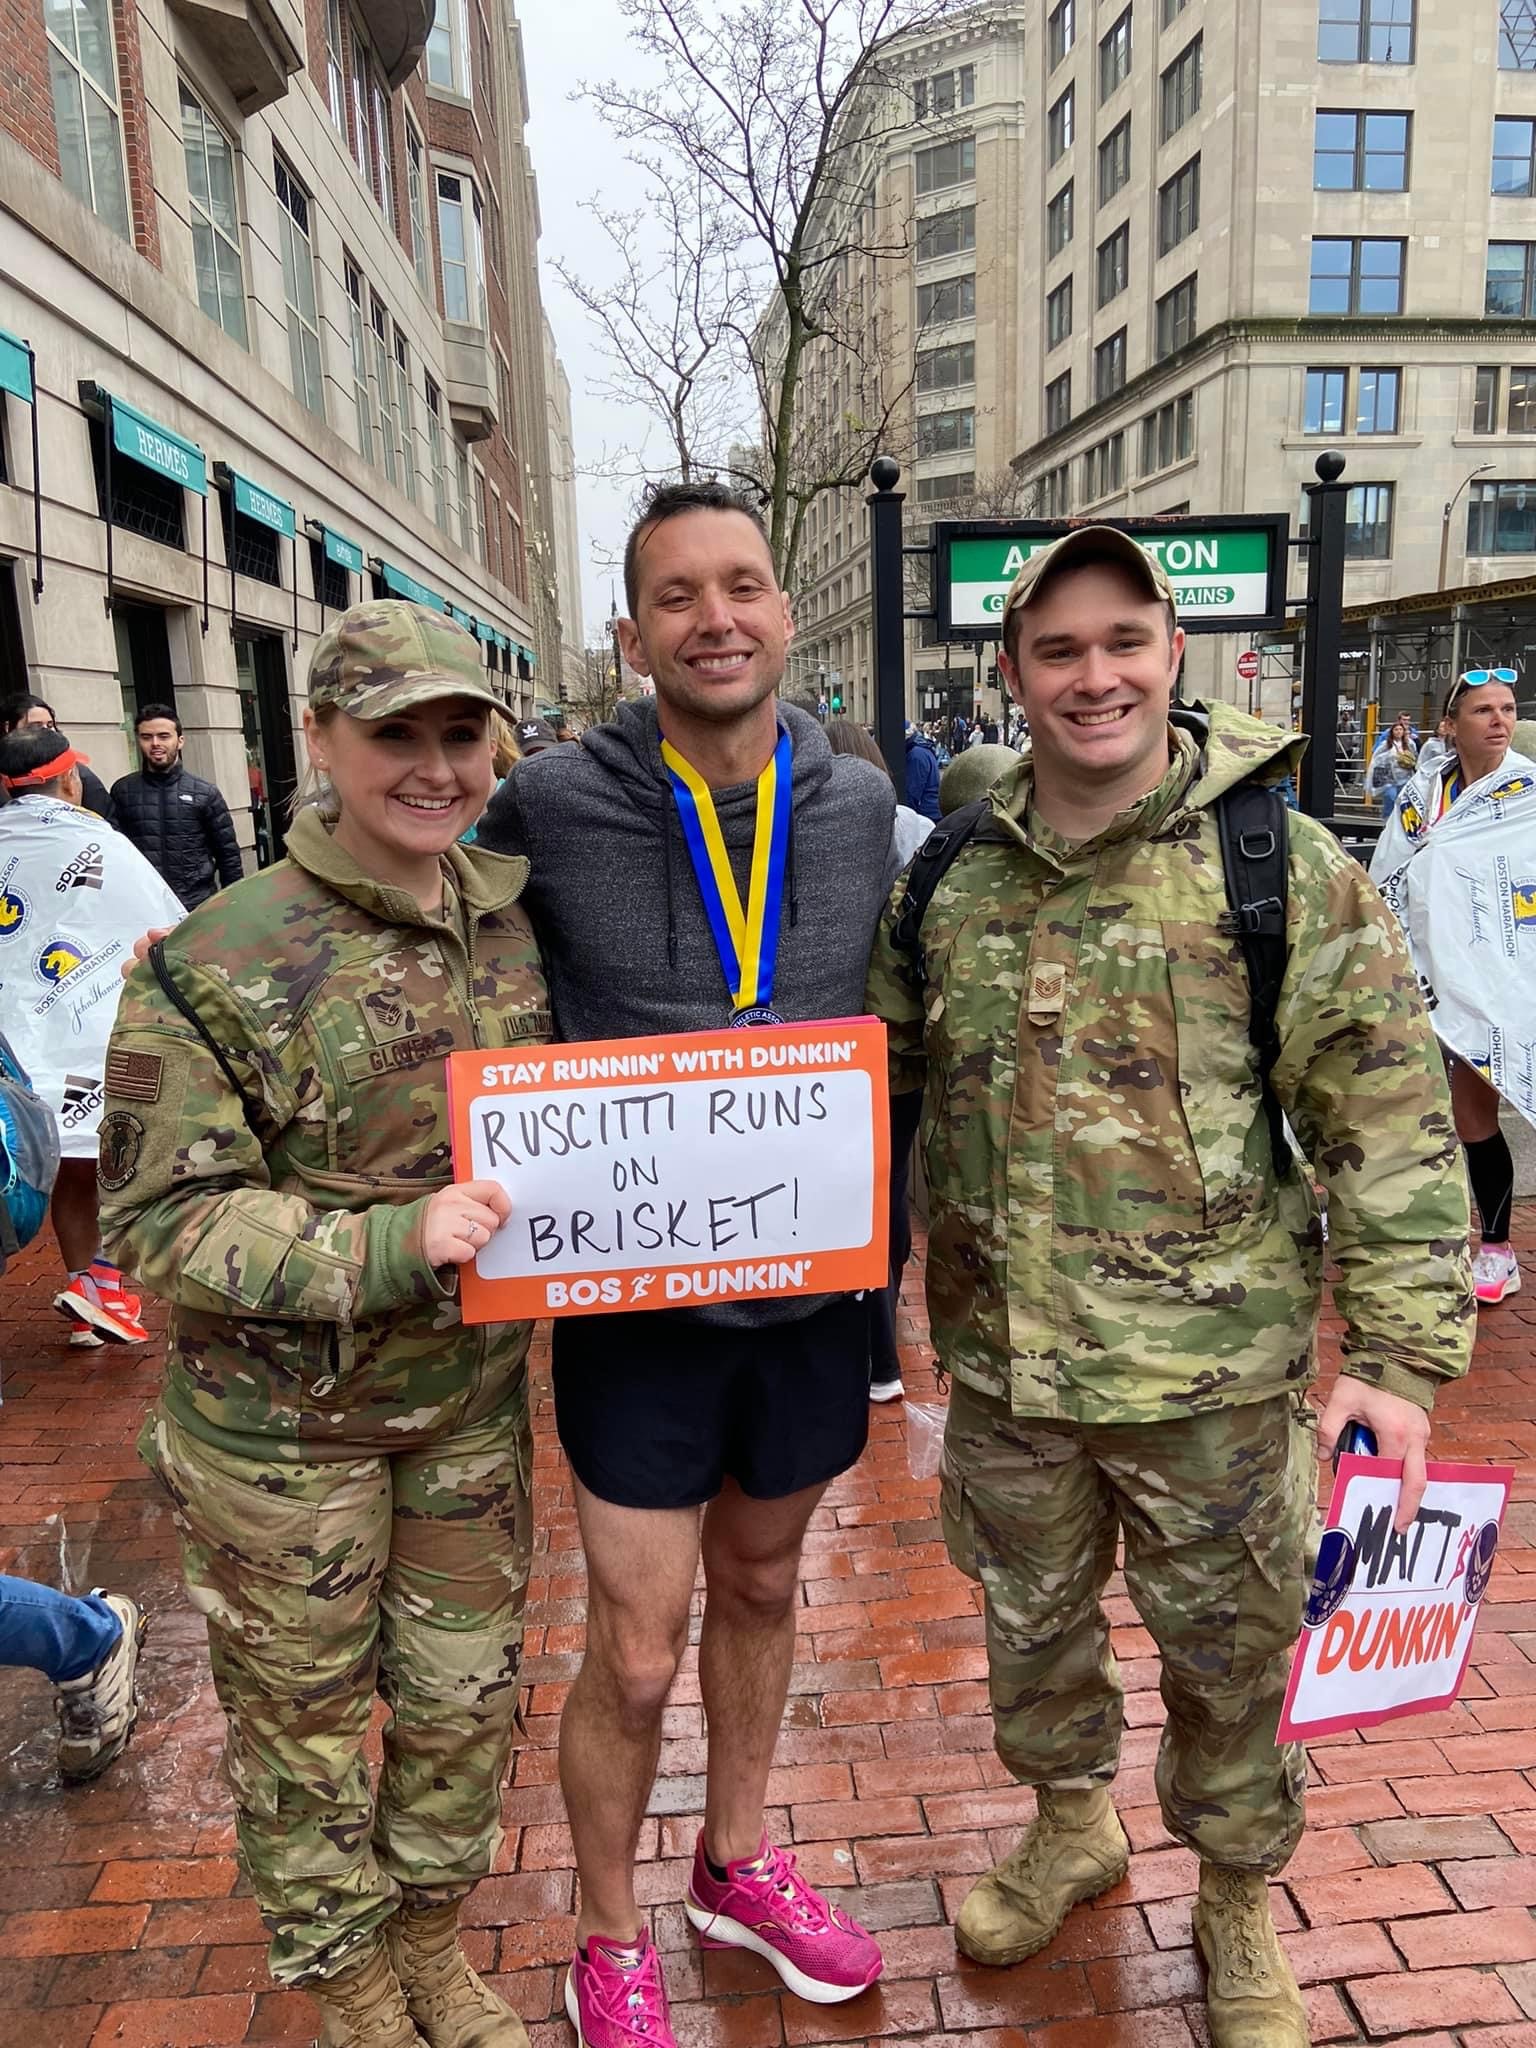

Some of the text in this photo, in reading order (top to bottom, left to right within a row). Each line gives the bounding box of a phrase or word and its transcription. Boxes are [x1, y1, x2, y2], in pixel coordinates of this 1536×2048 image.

[1174, 587, 1228, 605] RAINS
[0, 856, 19, 892] BOSTO
[56, 842, 101, 893] adidas
[1497, 856, 1516, 957] BOSTON MARATHON
[34, 941, 122, 1015] BOSTON MARATHON
[734, 1011, 761, 1029] THLETIC
[482, 1040, 857, 1087] STAY RUNNIN' WITH DUNKIN'
[62, 1090, 105, 1129] adida
[481, 1081, 828, 1168] RUSCITTI RUNS
[612, 1155, 659, 1192] ON
[545, 1260, 813, 1308] BOS DUNKIN'
[1353, 1504, 1462, 1589] MATT
